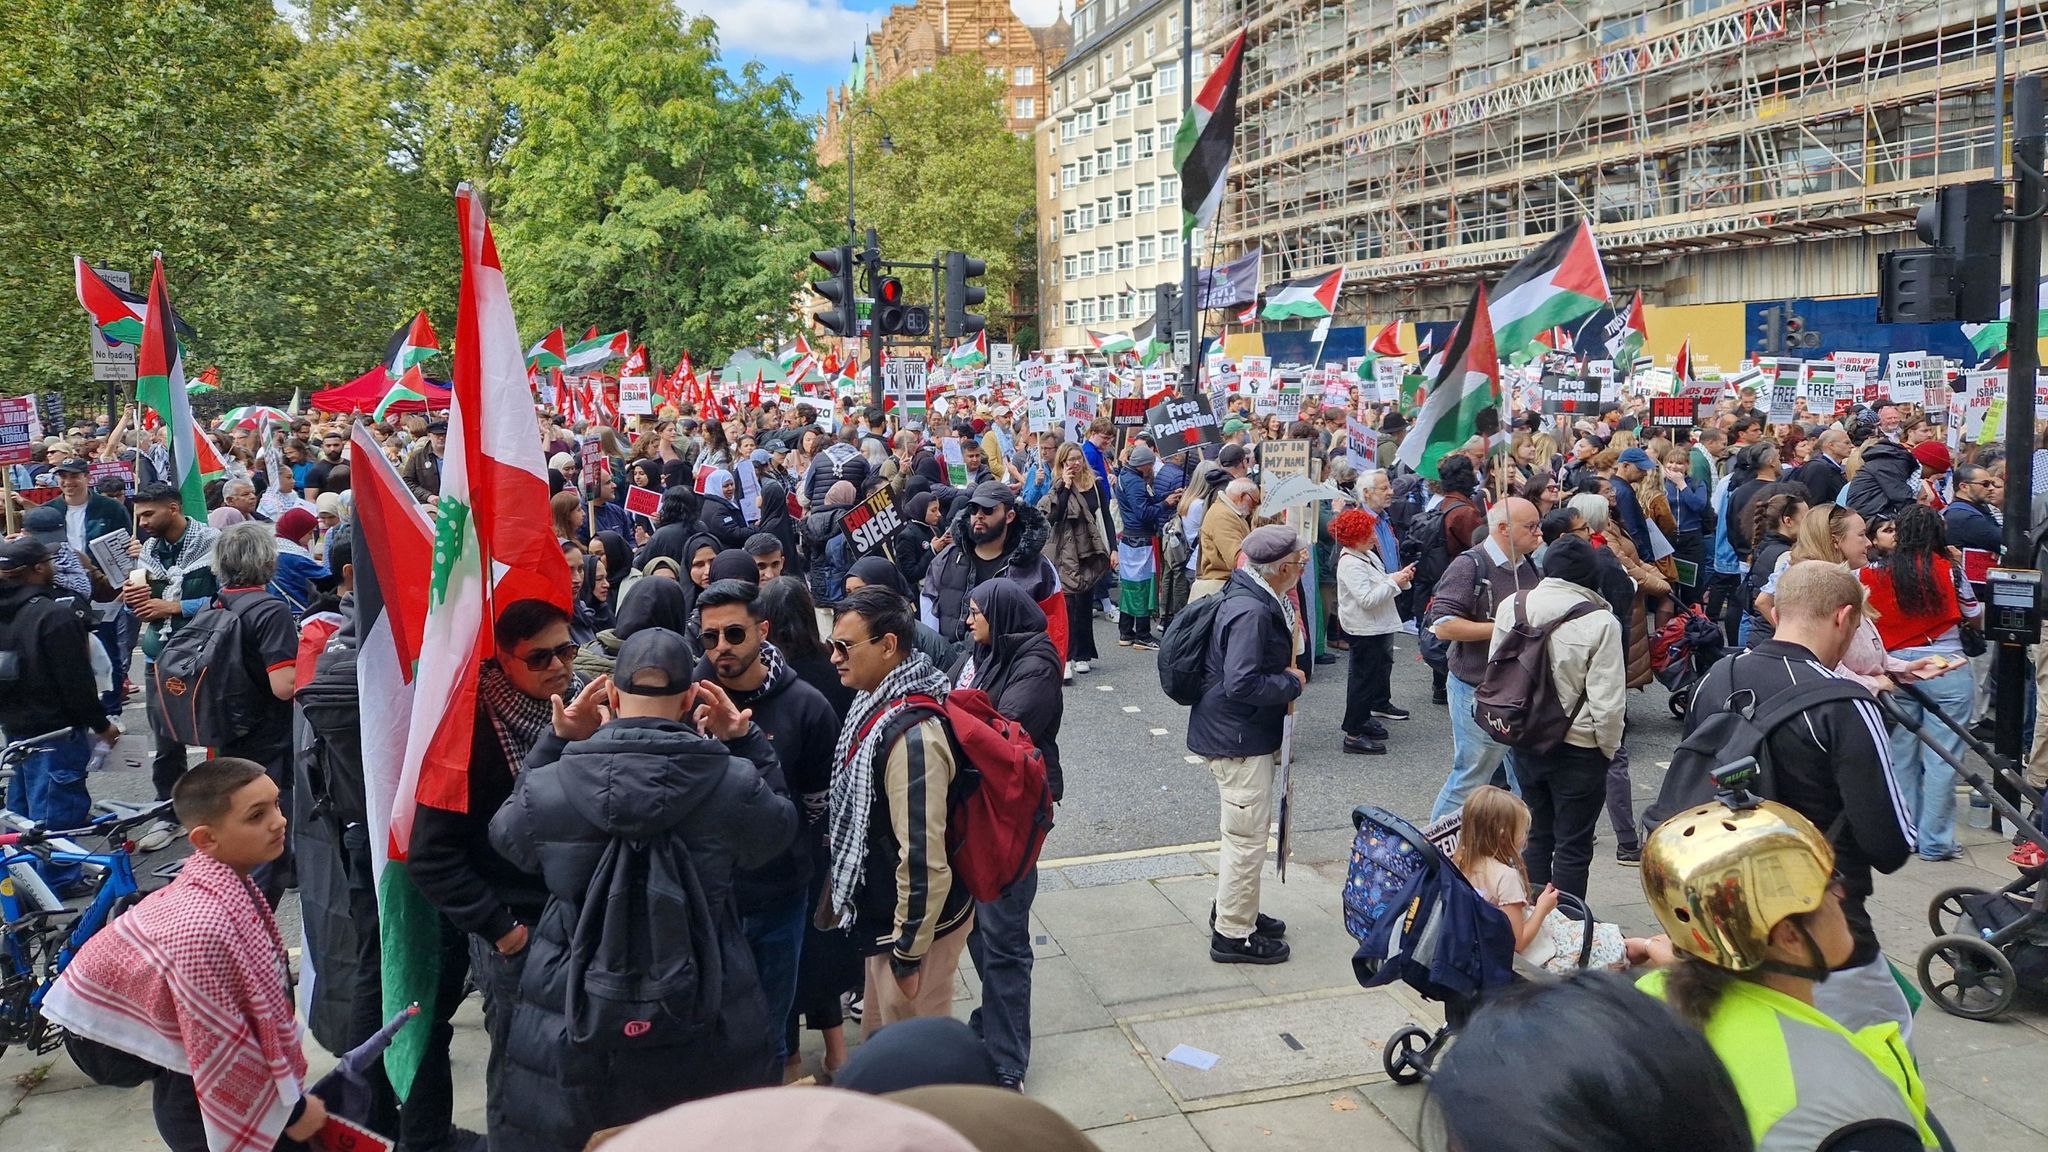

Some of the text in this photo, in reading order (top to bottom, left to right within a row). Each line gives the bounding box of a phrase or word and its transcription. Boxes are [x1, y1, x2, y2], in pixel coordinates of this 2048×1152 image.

[102, 274, 126, 283] stricted
[108, 350, 132, 360] loading
[1897, 360, 1920, 369] Stop
[1558, 378, 1585, 390] Free
[1984, 378, 1998, 388] END
[1544, 390, 1599, 402] Palestine
[1704, 388, 1720, 396] OFF
[1772, 386, 1796, 402] FREE
[1808, 384, 1834, 397] FREE
[1278, 394, 1300, 406] FREE
[1116, 399, 1146, 416] FREE
[1166, 400, 1200, 418] Free
[1654, 398, 1694, 416] FREE
[1114, 416, 1144, 424] PALESTINE
[1154, 412, 1215, 439] Palestine
[1654, 416, 1693, 426] PALESTINE
[1265, 442, 1304, 452] NOT IN
[1264, 456, 1306, 468] MY NAME
[844, 488, 892, 532] END THE
[852, 502, 902, 552] SIEGE
